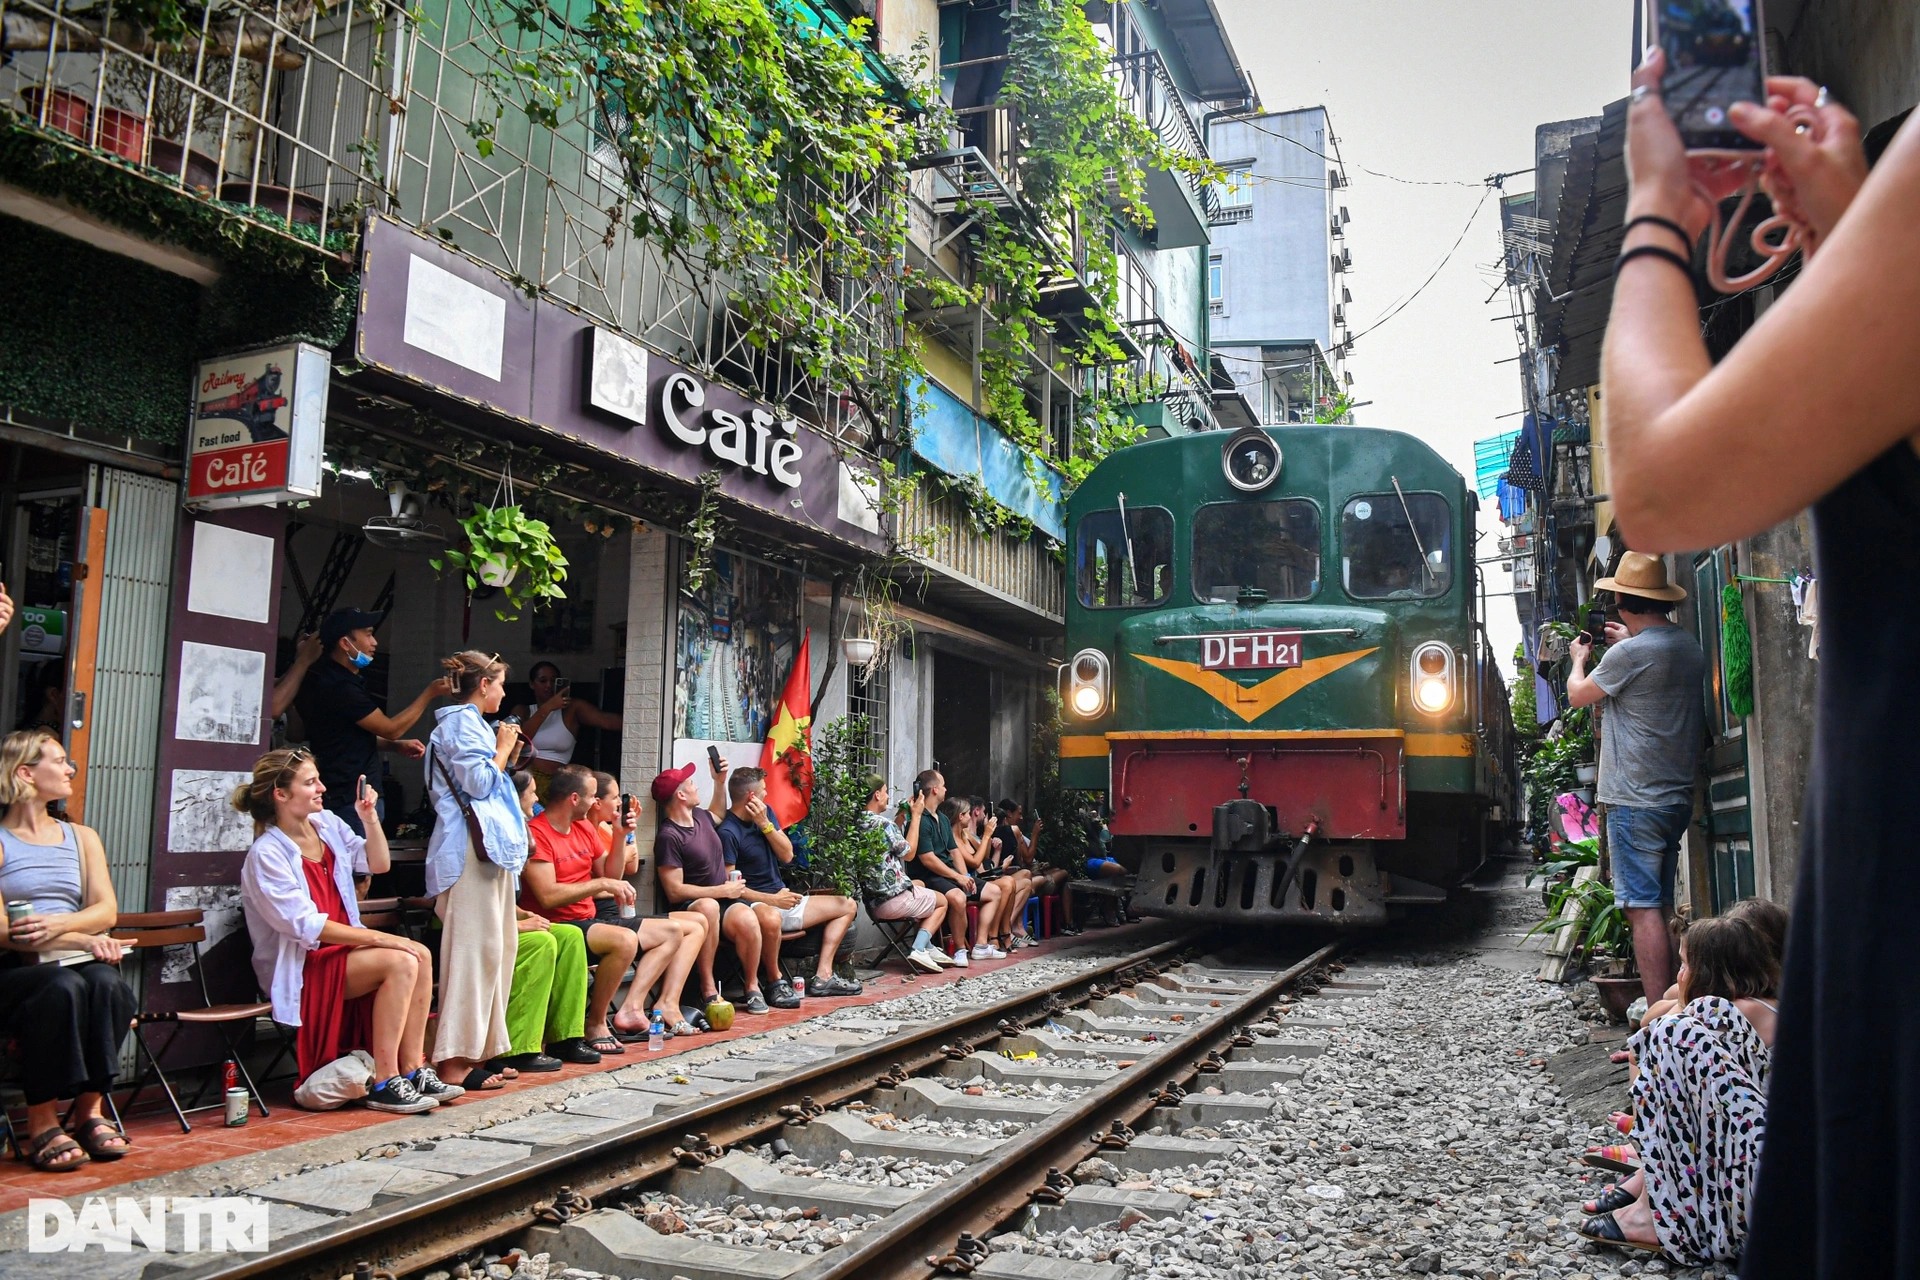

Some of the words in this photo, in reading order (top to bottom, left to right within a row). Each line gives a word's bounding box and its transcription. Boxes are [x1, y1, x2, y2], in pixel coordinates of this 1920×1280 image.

[202, 370, 246, 393] Railway
[199, 434, 218, 447] Fast
[220, 431, 241, 444] food
[662, 372, 803, 488] Café
[206, 452, 268, 488] Café
[1204, 635, 1298, 667] DFH21
